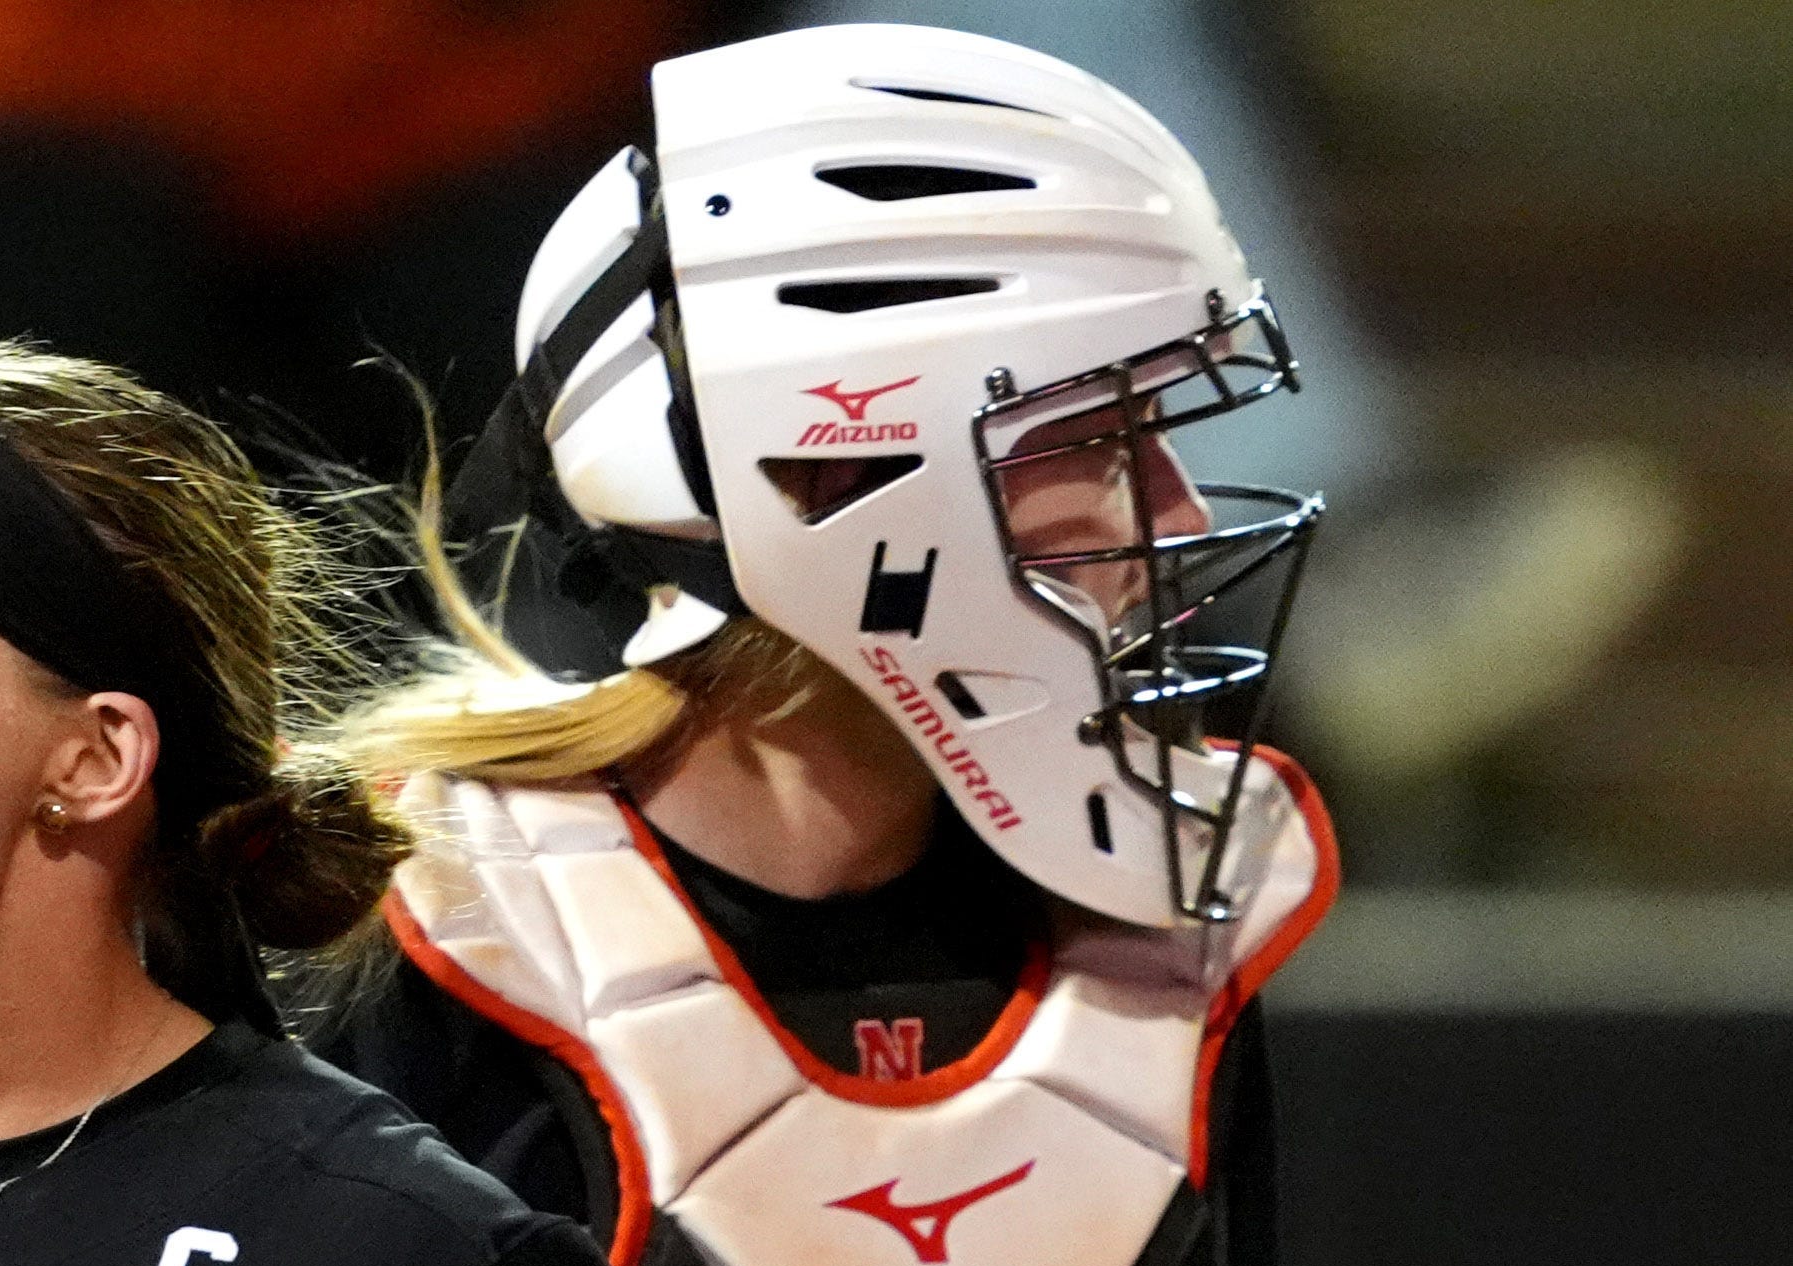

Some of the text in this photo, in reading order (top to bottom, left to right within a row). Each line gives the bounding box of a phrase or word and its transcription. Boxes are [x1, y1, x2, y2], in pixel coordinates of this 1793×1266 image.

[796, 421, 918, 447] MIZUNO
[859, 646, 1023, 831] SAMURAI
[854, 1017, 924, 1083] N
